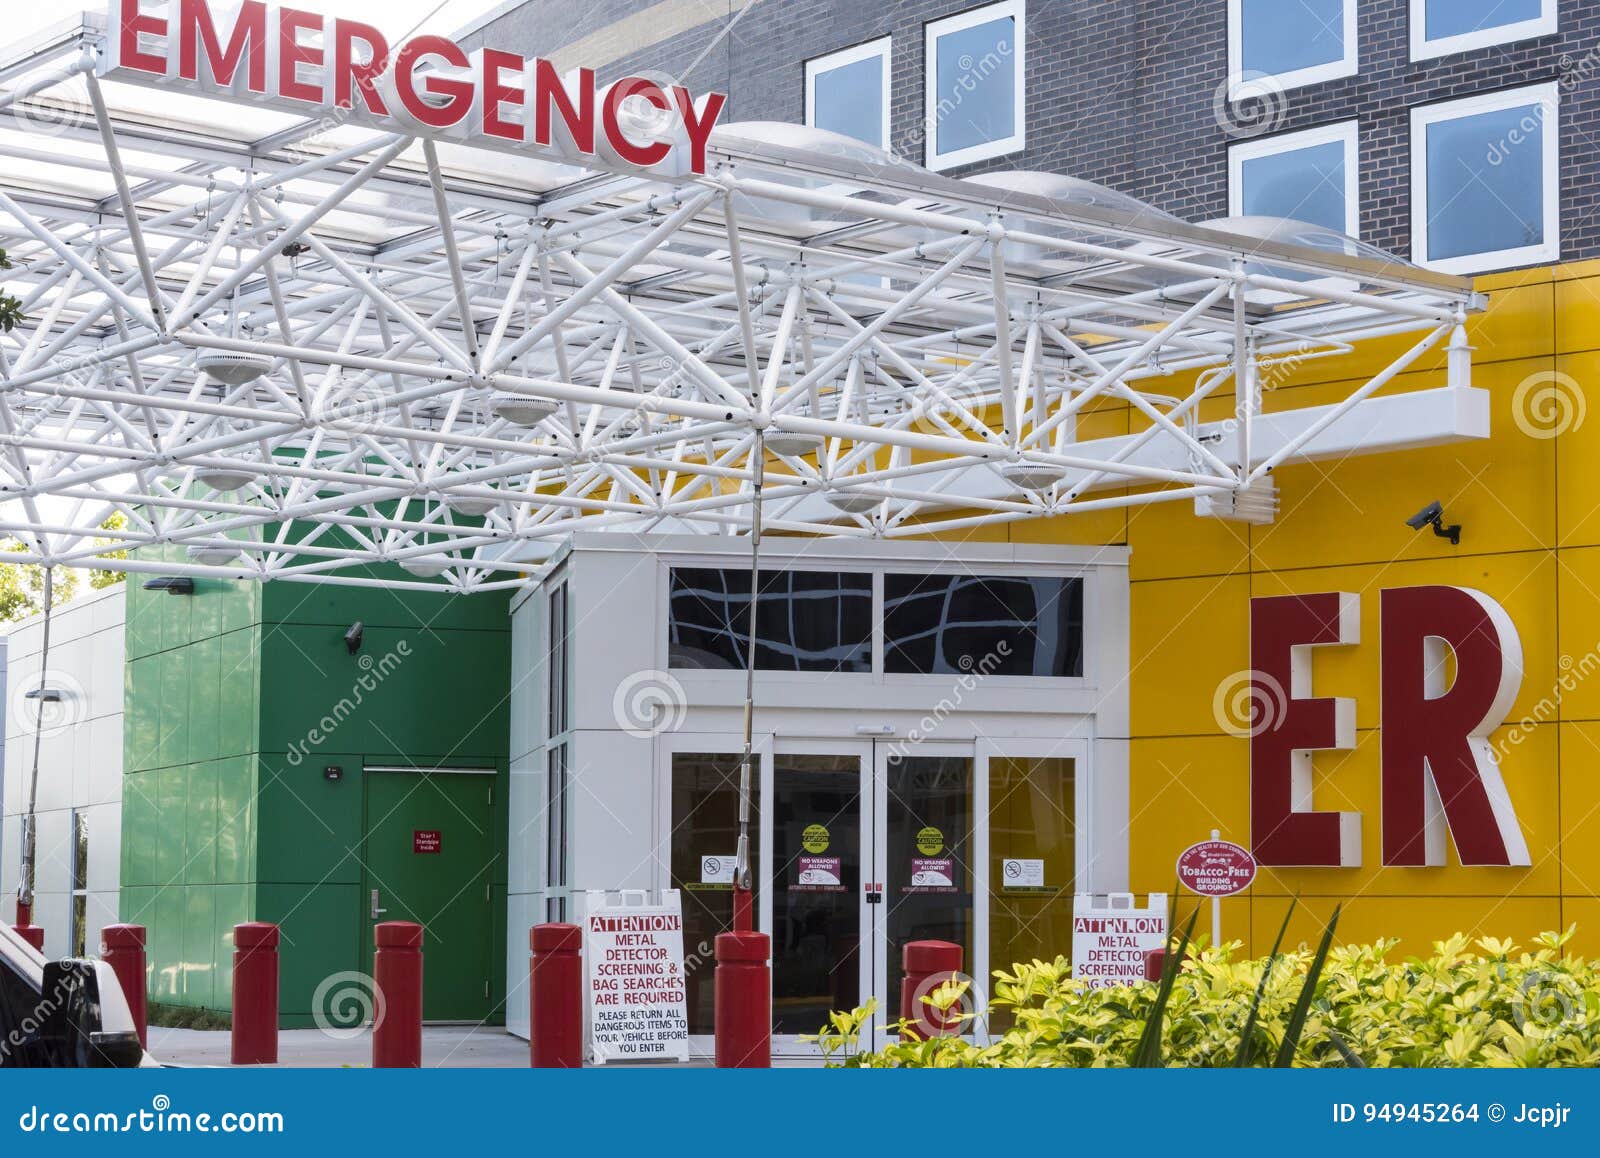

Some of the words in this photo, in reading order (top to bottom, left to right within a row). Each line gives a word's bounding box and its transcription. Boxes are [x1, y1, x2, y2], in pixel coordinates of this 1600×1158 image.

[118, 0, 727, 175] EMERGENCY
[1249, 585, 1531, 867] ER
[1196, 877, 1230, 885] BUILDING
[592, 916, 681, 932] ATTENTION!
[1076, 918, 1165, 933] ATTENTON!
[615, 933, 657, 946] METAL
[1098, 936, 1140, 948] METAL
[606, 948, 668, 961] DETECTOR
[598, 963, 664, 976] SCREENING
[669, 962, 678, 974] &
[1079, 964, 1144, 976] SCREENING
[593, 979, 619, 991] BAG
[623, 977, 684, 990] SEARCHES
[595, 993, 619, 1006] ARE
[624, 991, 684, 1006] REQUIRED
[598, 1010, 628, 1021] PLEASE
[630, 1010, 663, 1020] RETURN
[666, 1009, 681, 1018] ALL
[594, 1021, 646, 1032] DANGEROUS
[648, 1019, 672, 1030] ITEMS
[675, 1019, 687, 1029] TO
[595, 1033, 619, 1043] YOUR
[622, 1031, 655, 1042] VEHICLE
[657, 1030, 687, 1041] BEFORE
[618, 1044, 637, 1053] YOU
[640, 1043, 665, 1053] ENTER
